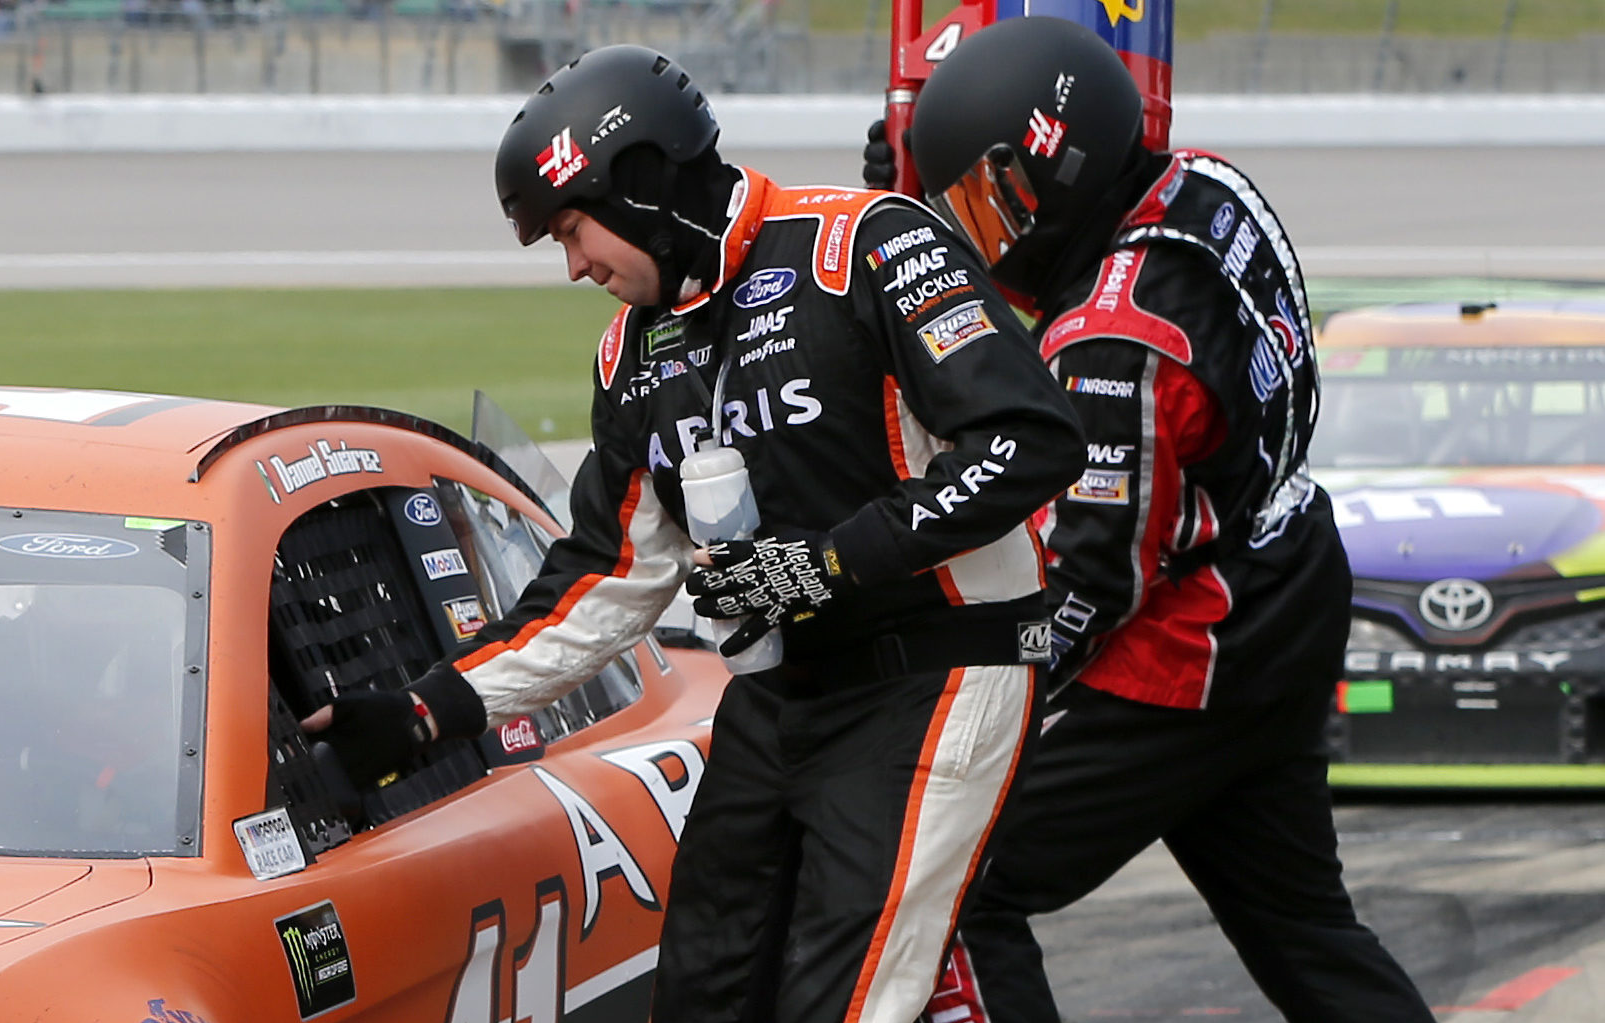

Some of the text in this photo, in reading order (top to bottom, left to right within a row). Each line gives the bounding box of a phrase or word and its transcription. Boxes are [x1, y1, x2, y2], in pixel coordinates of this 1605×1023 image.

[590, 112, 632, 145] ARRIS
[826, 219, 848, 268] SIMPSON
[883, 226, 937, 260] NASCAR
[883, 246, 949, 293] HAAS
[740, 272, 789, 306] Ford
[896, 269, 969, 316] RUCKUS
[736, 305, 795, 342] HAAS
[1081, 377, 1135, 399] NASCAR
[269, 443, 327, 495] Daniel
[911, 434, 1017, 532] ARRIS
[18, 534, 116, 558] Ford
